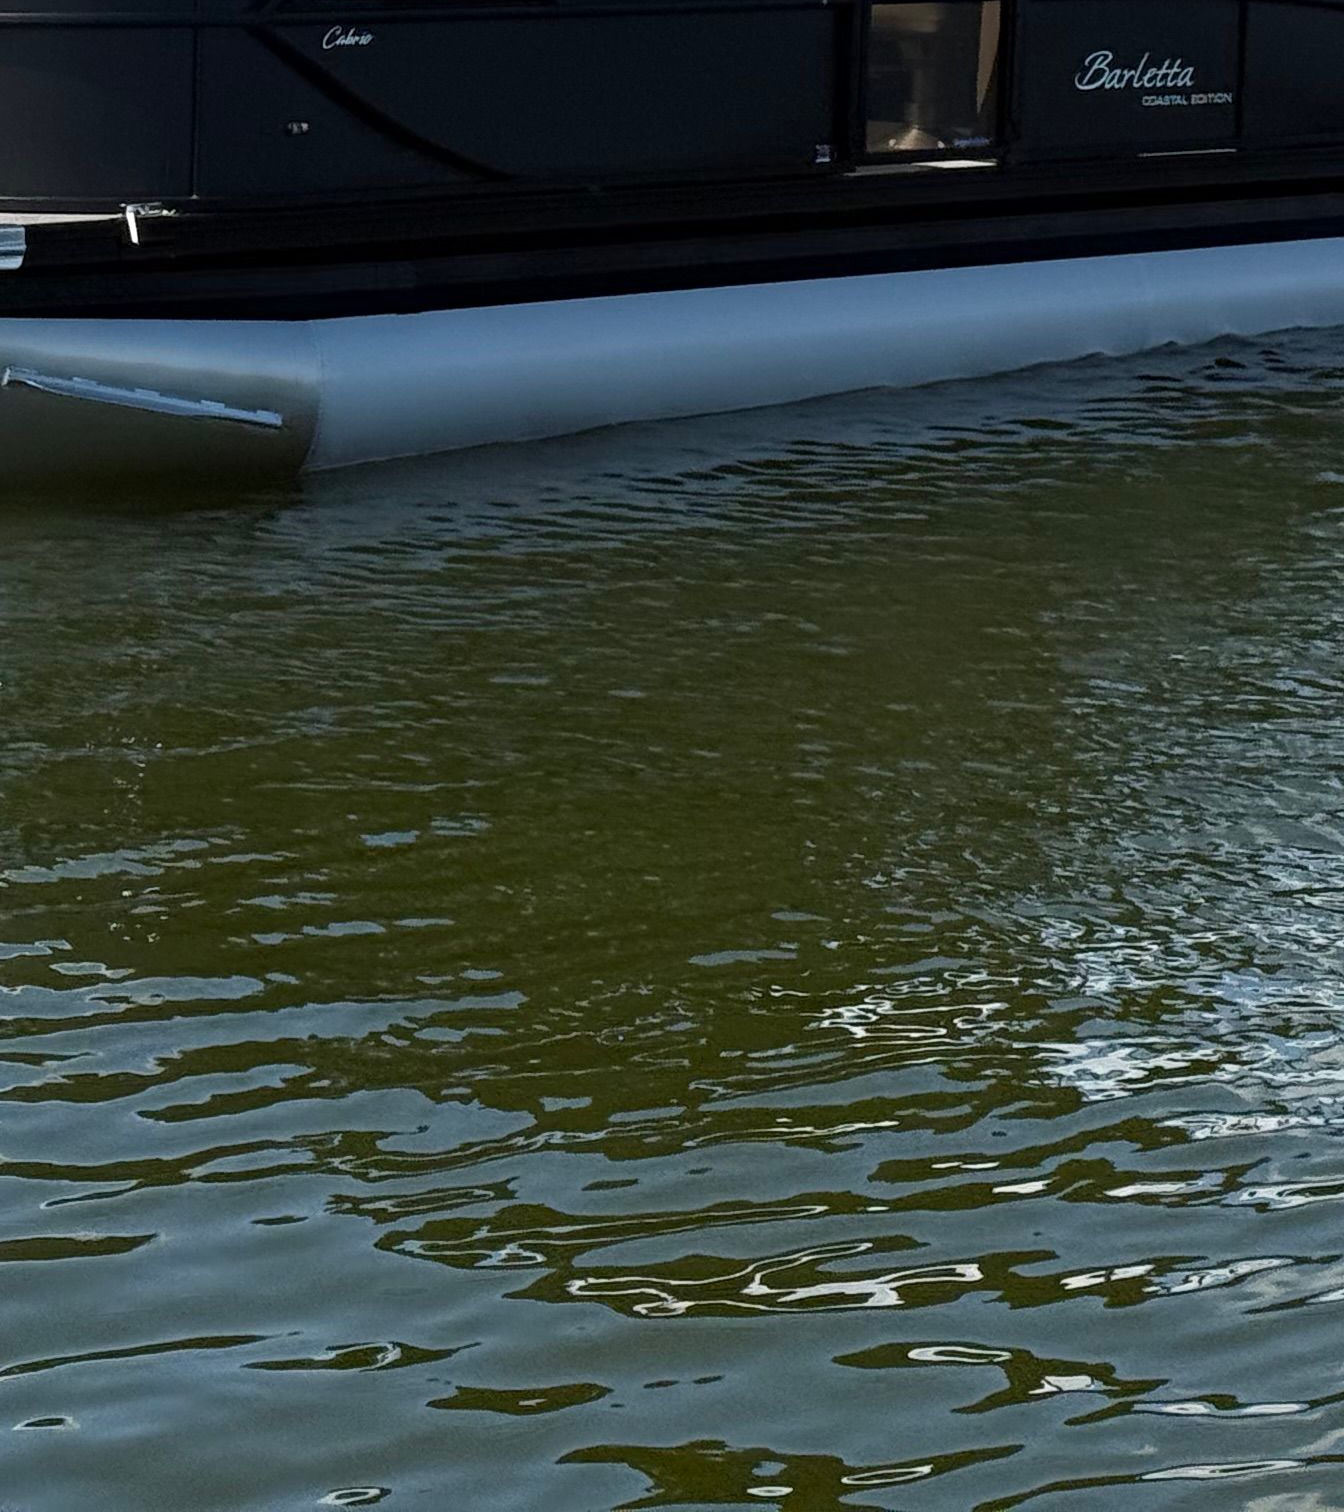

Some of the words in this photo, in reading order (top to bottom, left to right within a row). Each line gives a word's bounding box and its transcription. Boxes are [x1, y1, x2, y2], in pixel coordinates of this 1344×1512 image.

[322, 25, 374, 49] Cabrio
[1074, 50, 1195, 90] Barletta
[1142, 95, 1188, 106] COASTAL
[1191, 93, 1233, 105] EDITION
